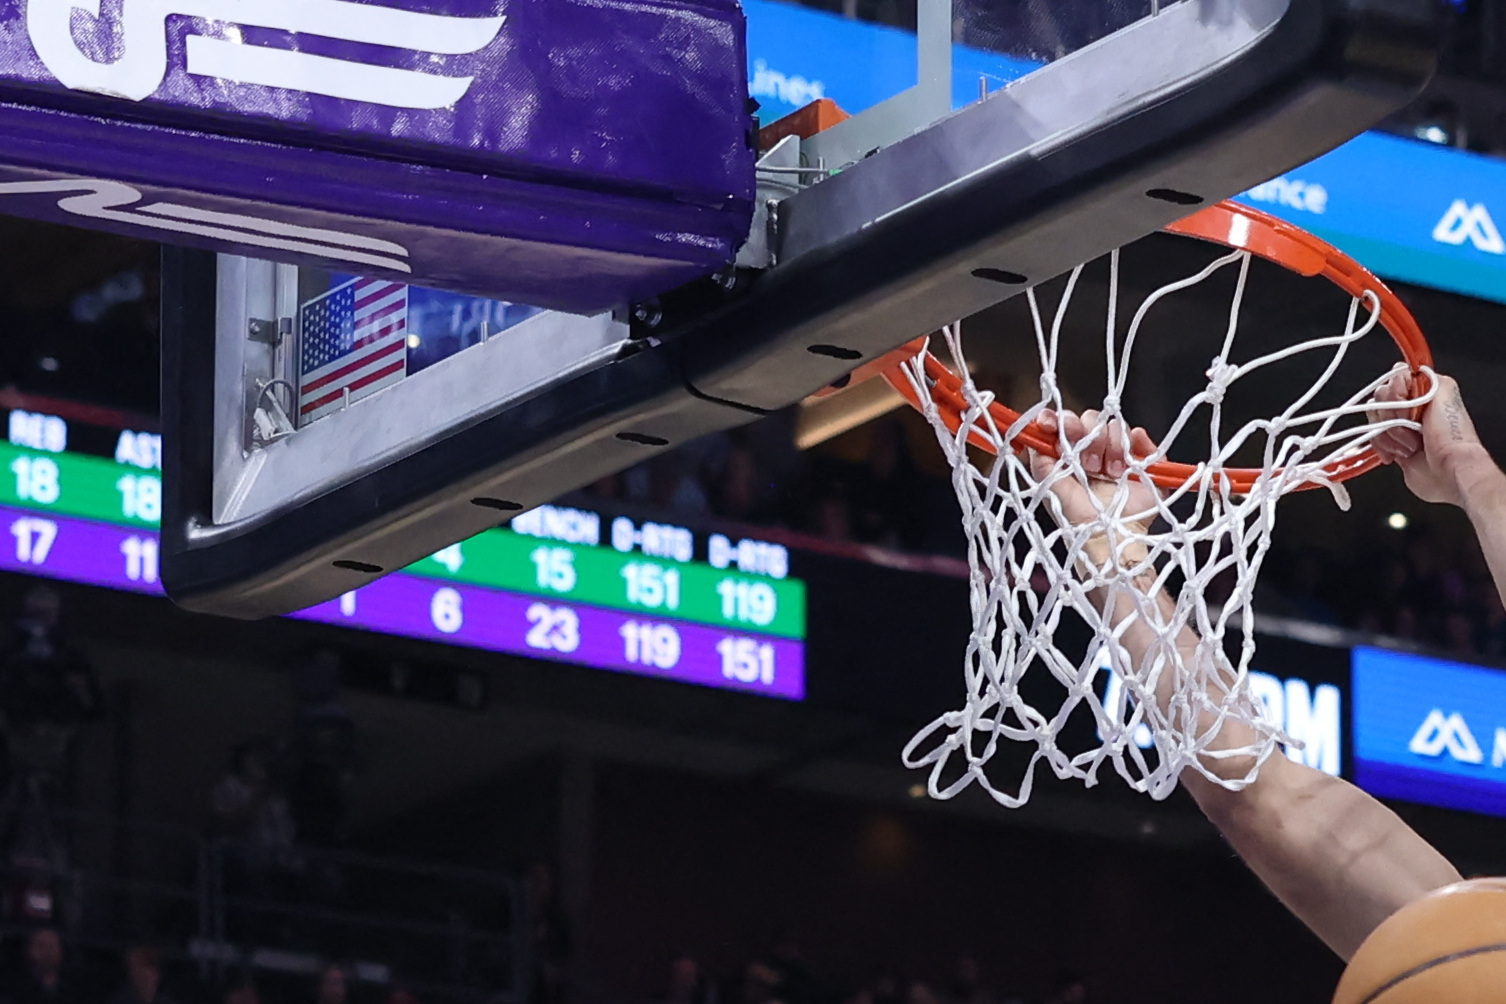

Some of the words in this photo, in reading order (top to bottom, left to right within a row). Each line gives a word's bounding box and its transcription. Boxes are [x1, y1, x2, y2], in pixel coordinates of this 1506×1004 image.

[1239, 176, 1328, 214] ance
[10, 455, 60, 504] 18
[115, 473, 162, 522] 18
[10, 516, 57, 565] 17
[120, 535, 158, 584] 11
[530, 547, 576, 592] 15
[620, 560, 680, 611] 151
[717, 577, 776, 626] 119
[431, 587, 463, 633] 6
[526, 602, 580, 652] 23
[619, 619, 681, 669] 119
[716, 634, 775, 686] 151
